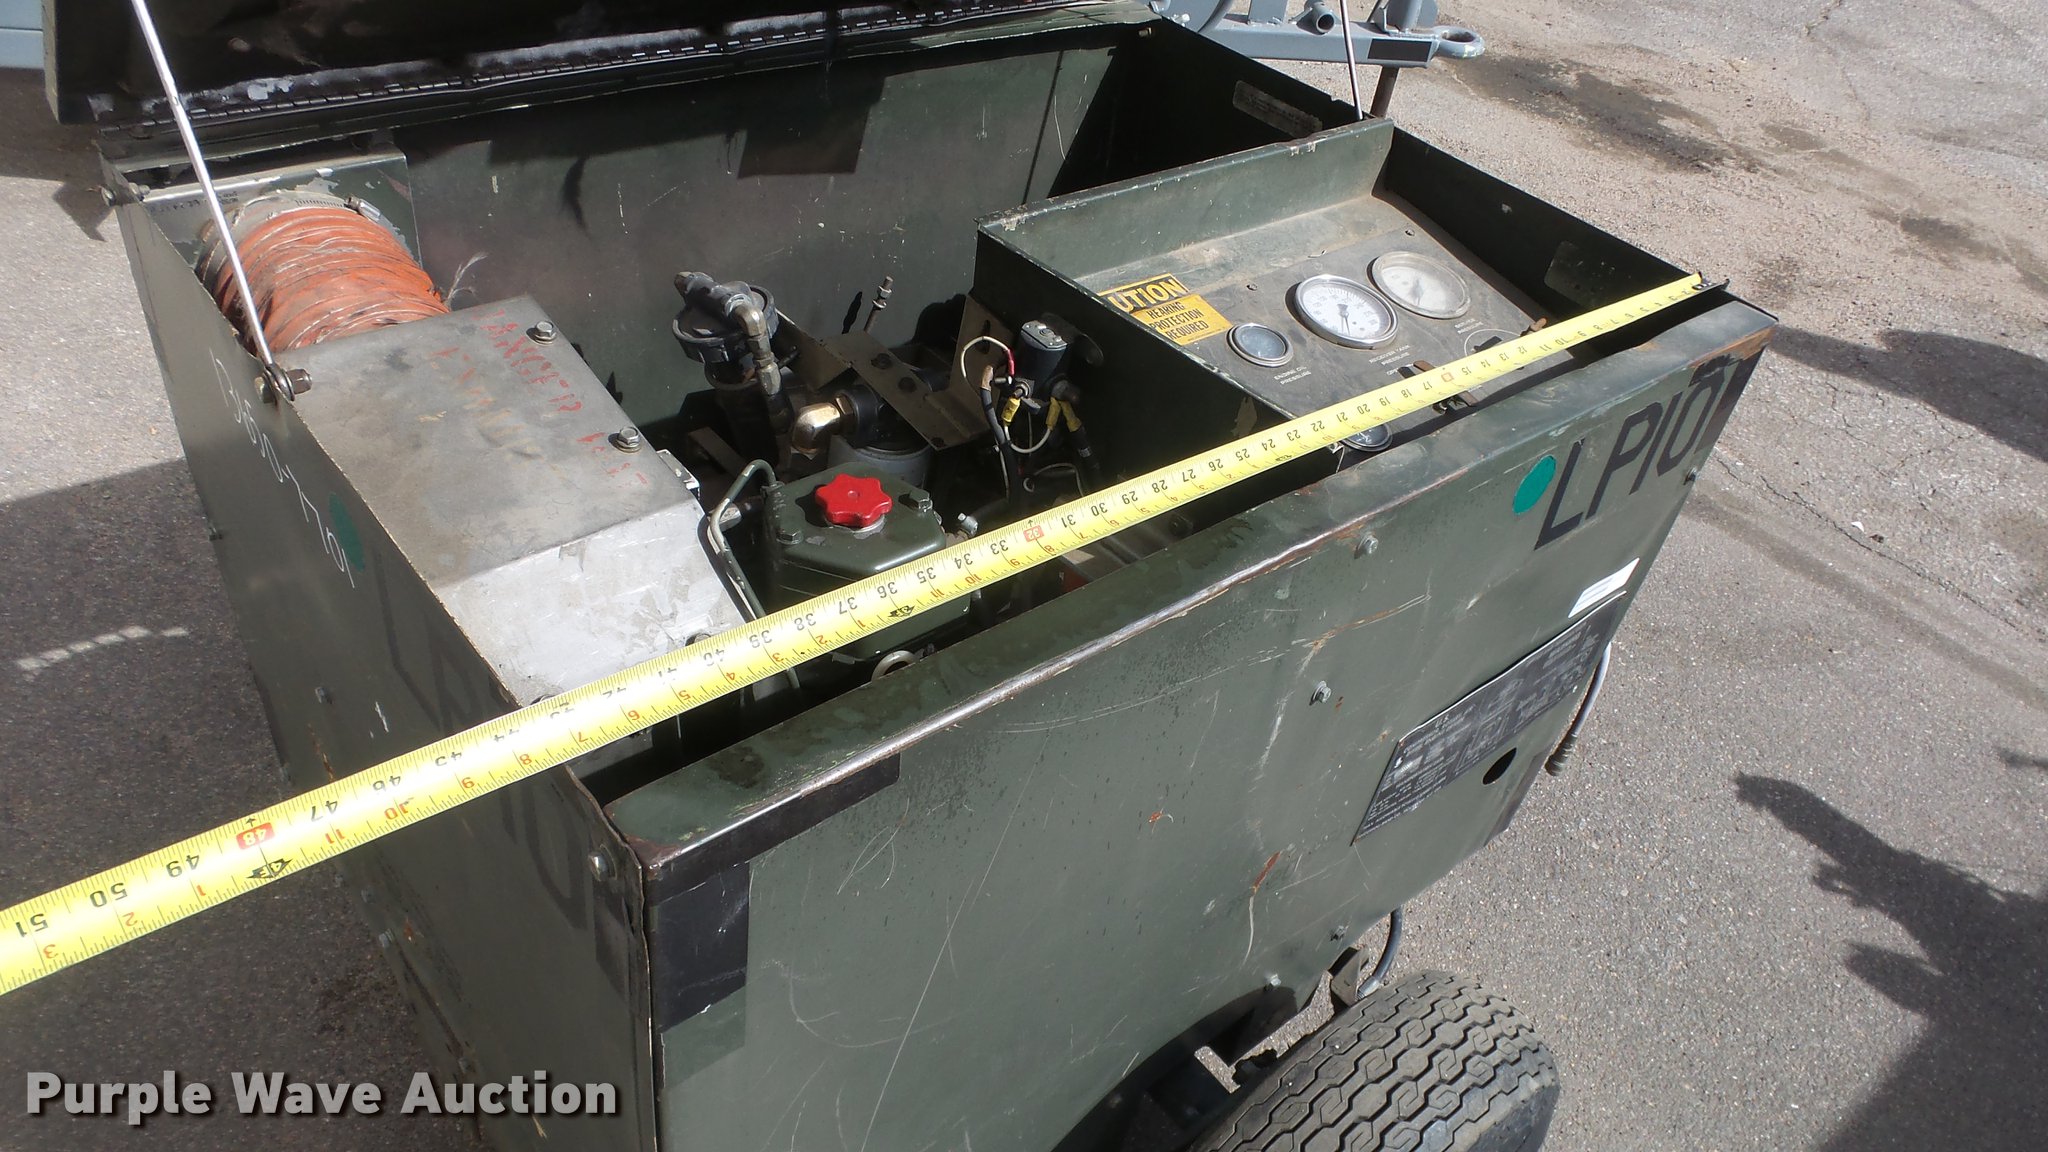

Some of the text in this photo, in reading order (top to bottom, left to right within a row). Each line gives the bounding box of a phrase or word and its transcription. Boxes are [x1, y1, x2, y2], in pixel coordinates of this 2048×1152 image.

[1107, 278, 1187, 312] UTION
[1146, 302, 1185, 320] HEARING
[1149, 309, 1204, 330] PROTECTION
[1165, 321, 1209, 340] REQUIRED
[1280, 371, 1312, 384] PRESSURE
[1461, 366, 1472, 376] 15
[1422, 381, 1433, 391] 17
[1401, 388, 1412, 399] 18
[1378, 396, 1391, 407] 19
[1356, 403, 1371, 415] 20
[1336, 411, 1349, 423] 21
[1310, 420, 1326, 433] 22
[1286, 429, 1301, 442] 23
[1261, 438, 1276, 452] 24
[1235, 448, 1250, 462] 25
[1208, 458, 1224, 472] 26
[1181, 468, 1197, 483] 27
[1151, 479, 1168, 494] 28
[1121, 491, 1138, 505] 29
[1091, 502, 1108, 517] 30
[1061, 514, 1076, 529] 31
[1026, 527, 1042, 541] 32
[990, 539, 1009, 555] 33
[1043, 544, 1055, 554] 8
[954, 553, 974, 570] 34
[1009, 558, 1021, 568] 9
[917, 567, 937, 584] 35
[964, 574, 982, 586] 10
[877, 581, 898, 599] 36
[930, 588, 945, 599] 11
[838, 596, 858, 615] 37
[793, 613, 817, 631] 38
[855, 619, 866, 628] 1
[749, 629, 773, 649] 39
[815, 634, 828, 645] 2
[772, 652, 785, 664] 3
[725, 671, 736, 682] 4
[678, 689, 692, 701] 5
[627, 710, 640, 722] 6
[577, 731, 589, 743] 7
[519, 754, 533, 766] 8
[461, 777, 475, 789] 9
[311, 800, 338, 822] 47
[384, 803, 409, 820] 10
[242, 826, 268, 845] 48
[325, 829, 347, 844] 11
[165, 854, 200, 878] 49
[89, 882, 128, 908] 50
[196, 885, 206, 897] 1
[15, 913, 49, 938] 51
[122, 911, 138, 927] 2
[42, 944, 59, 959] 3
